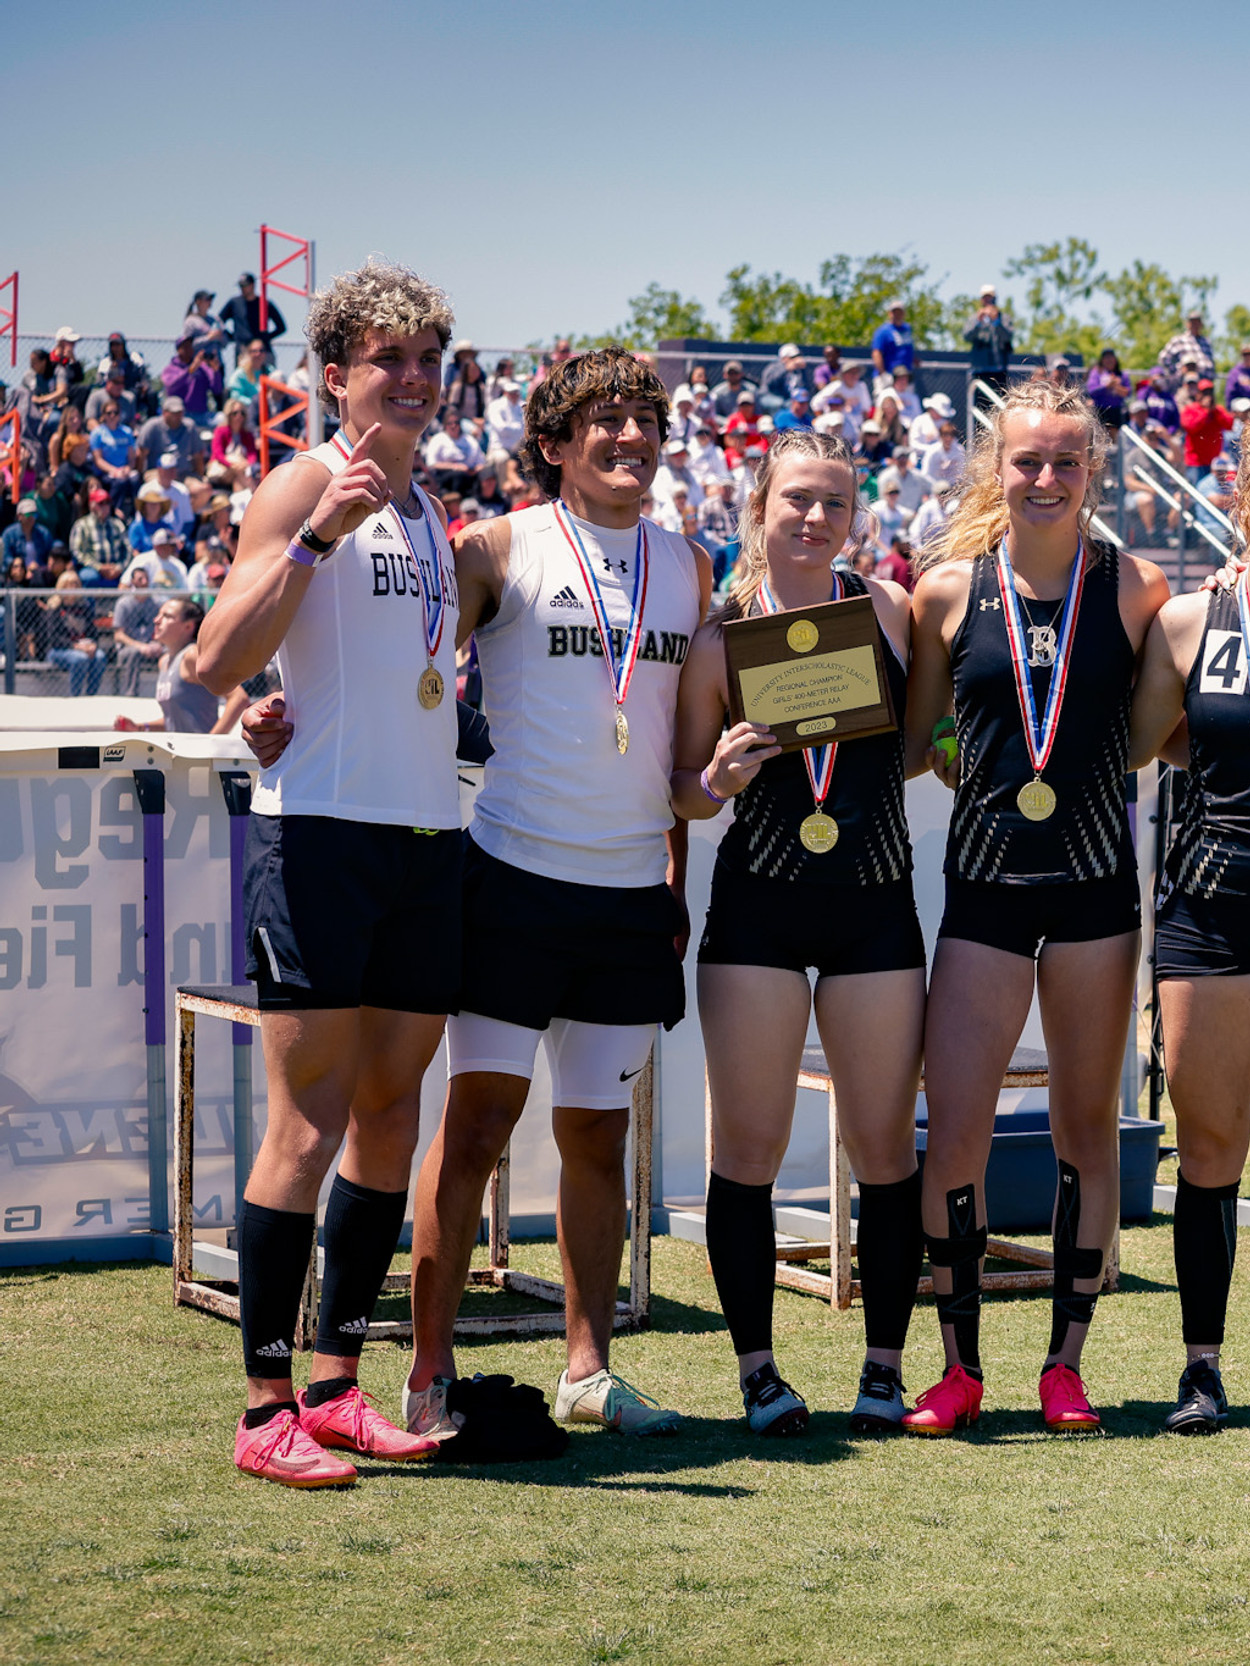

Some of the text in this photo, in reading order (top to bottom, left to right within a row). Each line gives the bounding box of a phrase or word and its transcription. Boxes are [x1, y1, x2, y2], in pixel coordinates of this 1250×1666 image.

[549, 598, 585, 610] adidas
[1027, 625, 1057, 667] B
[1206, 636, 1242, 689] 4
[751, 662, 872, 707] UNIVERSITY INTERSCHOLASTIC LEAGUE
[776, 674, 843, 693] REGIONAL CHAMPION
[772, 683, 850, 705] GIRLS' 400-METER RELAY
[784, 696, 841, 713] CONFERENCE AAA
[805, 721, 828, 732] 2023
[956, 1195, 968, 1206] KT
